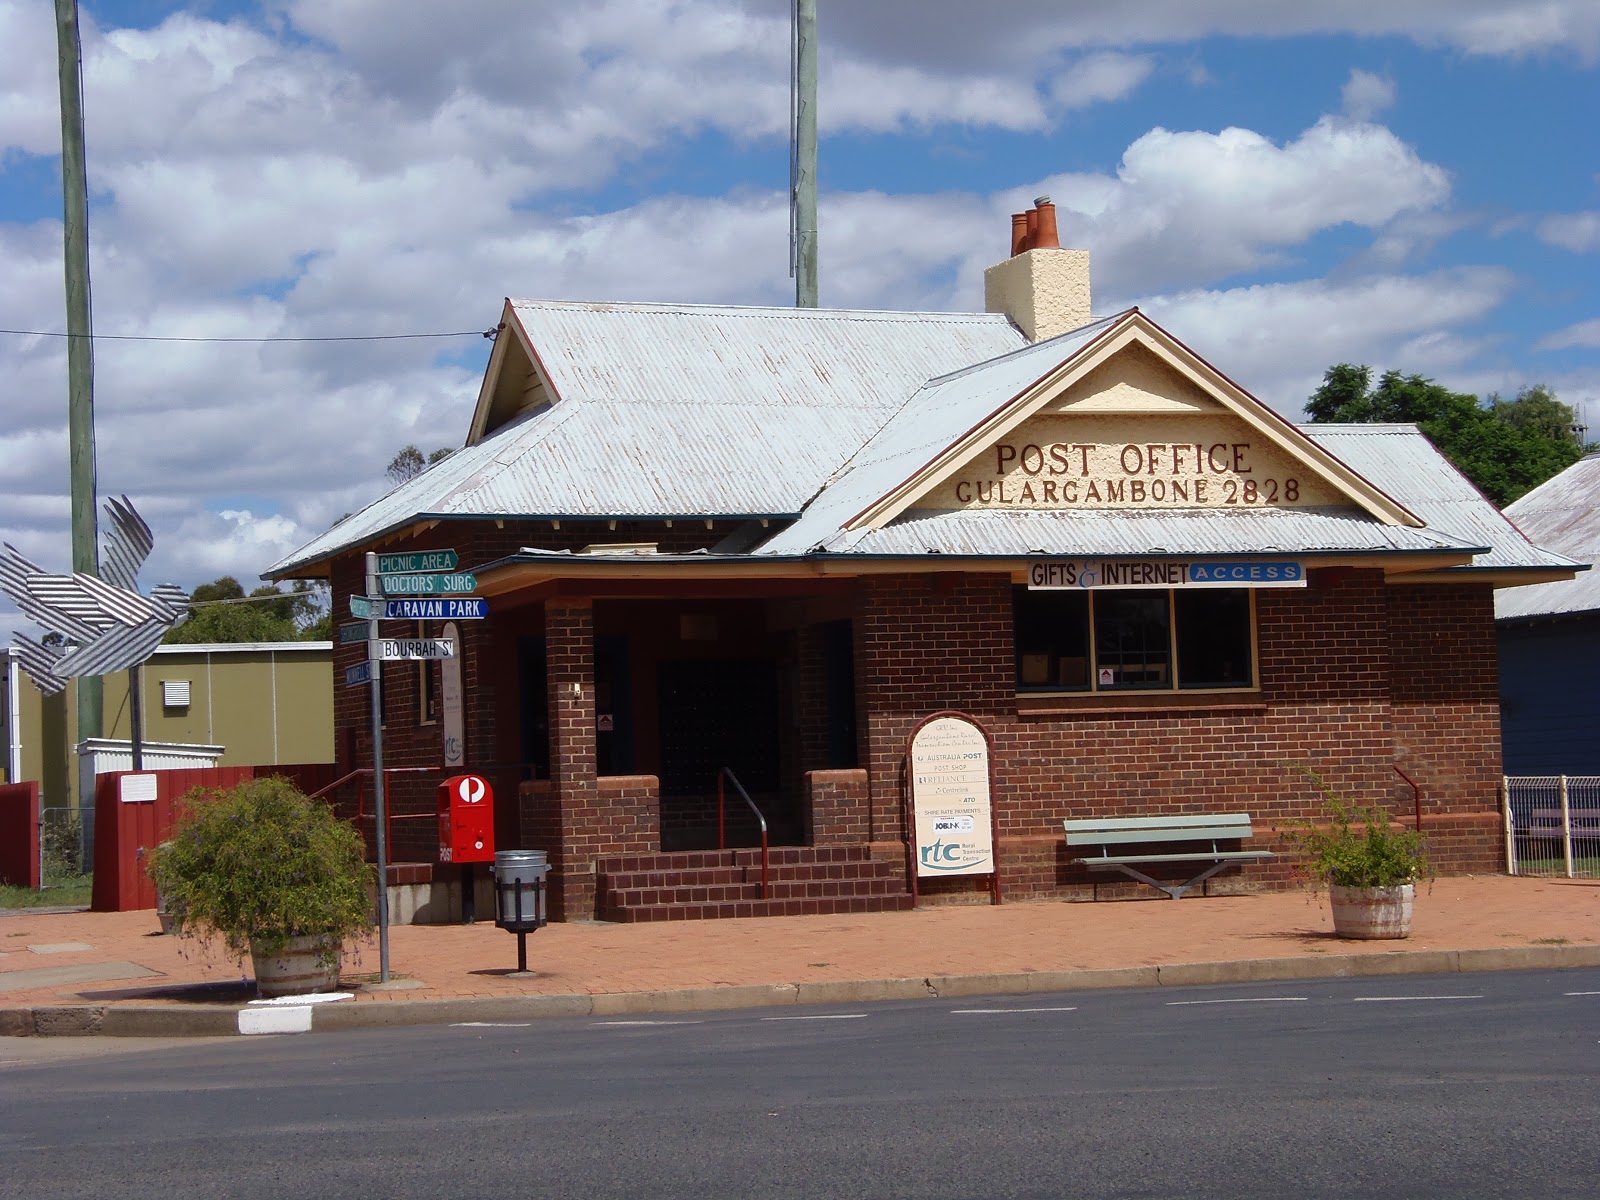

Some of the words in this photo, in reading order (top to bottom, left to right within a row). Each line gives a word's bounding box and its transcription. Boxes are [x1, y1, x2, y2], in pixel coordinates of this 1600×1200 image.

[996, 442, 1096, 477] POST
[1120, 443, 1252, 475] OFFICE
[956, 479, 1210, 504] GULARGAMBONE
[1223, 478, 1299, 505] 2828
[380, 555, 416, 572] PICNIC
[421, 553, 452, 569] AREA
[1031, 562, 1077, 586] GIFTS
[1078, 559, 1097, 588] &
[1101, 562, 1189, 585] INTERNET
[1195, 567, 1297, 580] ACCESS
[384, 575, 433, 592] DOCTORS
[443, 575, 472, 591] SURG
[388, 601, 443, 617] CARAVAN
[449, 600, 480, 616] PARK
[385, 641, 436, 657] BOURBAH
[442, 640, 453, 656] ST
[928, 775, 967, 784] RELIANCE
[440, 847, 453, 862] POST
[920, 838, 961, 863] rtc
